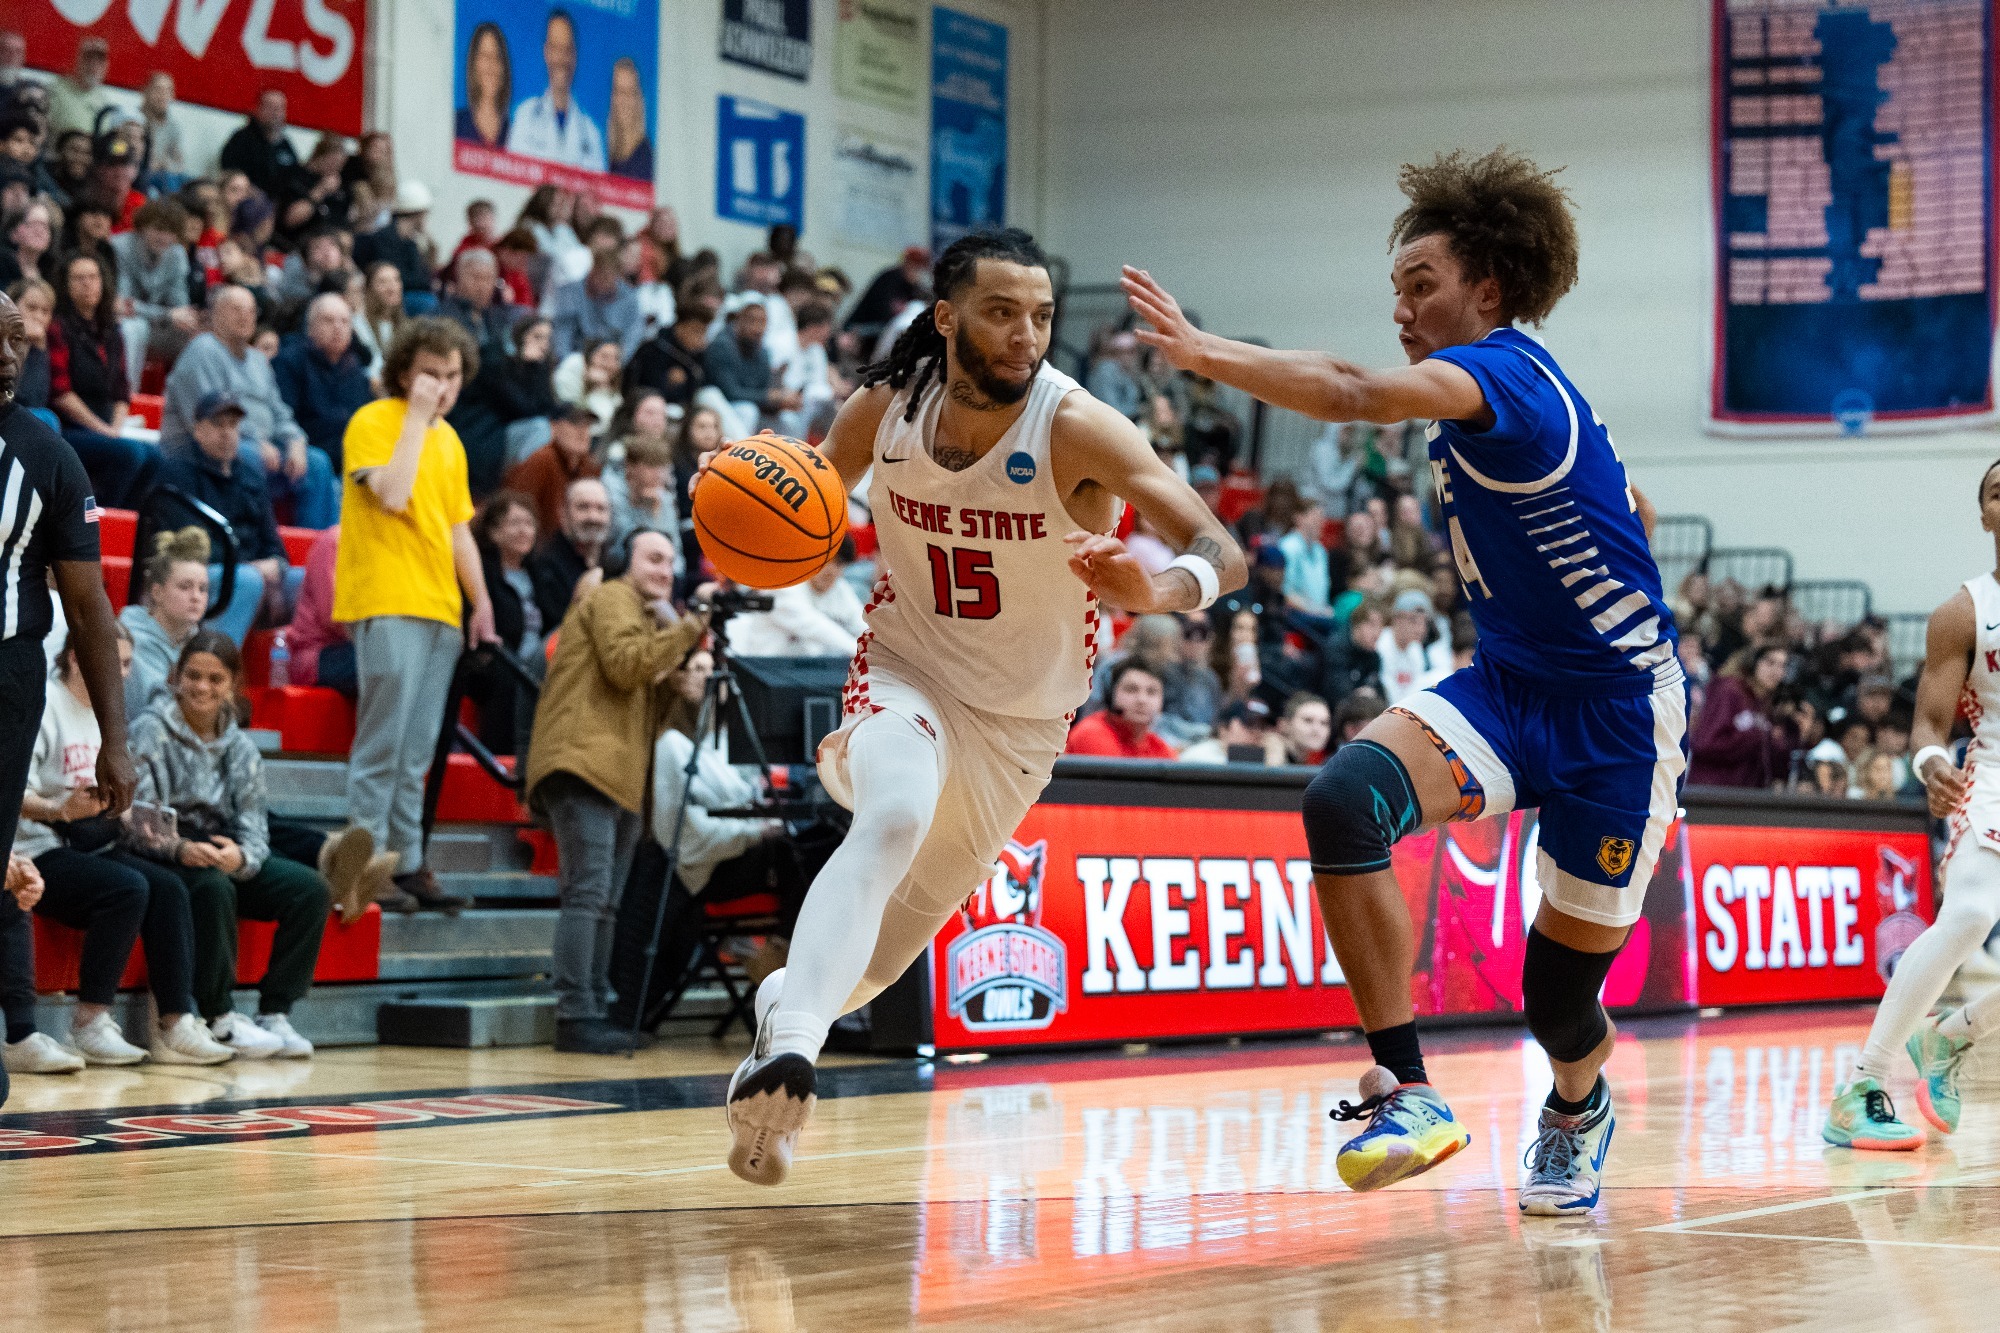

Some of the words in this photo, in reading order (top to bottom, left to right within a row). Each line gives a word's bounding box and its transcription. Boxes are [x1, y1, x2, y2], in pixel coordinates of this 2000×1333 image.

[727, 445, 809, 514] Wilson
[1010, 466, 1034, 477] NCAA
[886, 485, 954, 535] KEENE
[959, 507, 1048, 541] STATE
[926, 542, 1002, 620] 15
[1702, 863, 1865, 973] STATE
[983, 987, 1035, 1021] OWLS
